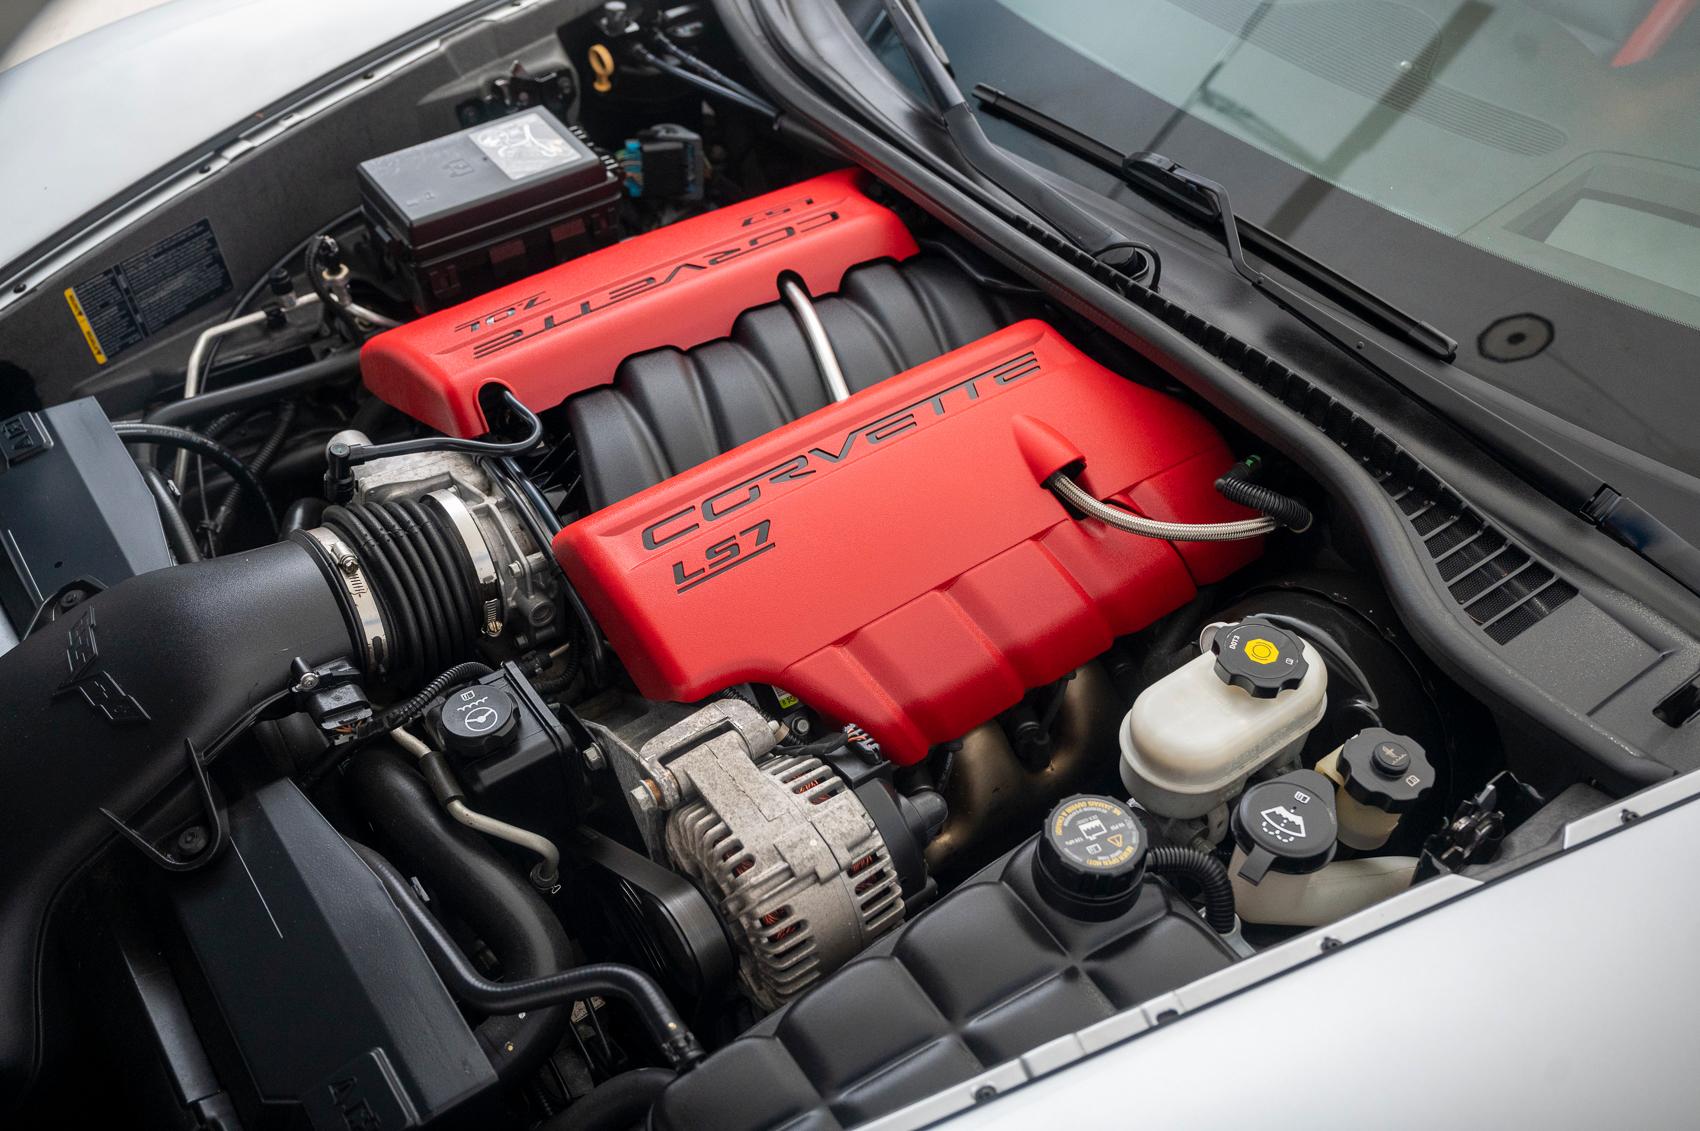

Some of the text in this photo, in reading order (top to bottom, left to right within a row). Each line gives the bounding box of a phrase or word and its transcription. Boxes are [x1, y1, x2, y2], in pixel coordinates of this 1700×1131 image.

[473, 211, 839, 359] CORVETTE
[642, 351, 1042, 551] CORVETTE
[672, 519, 772, 585] LS7
